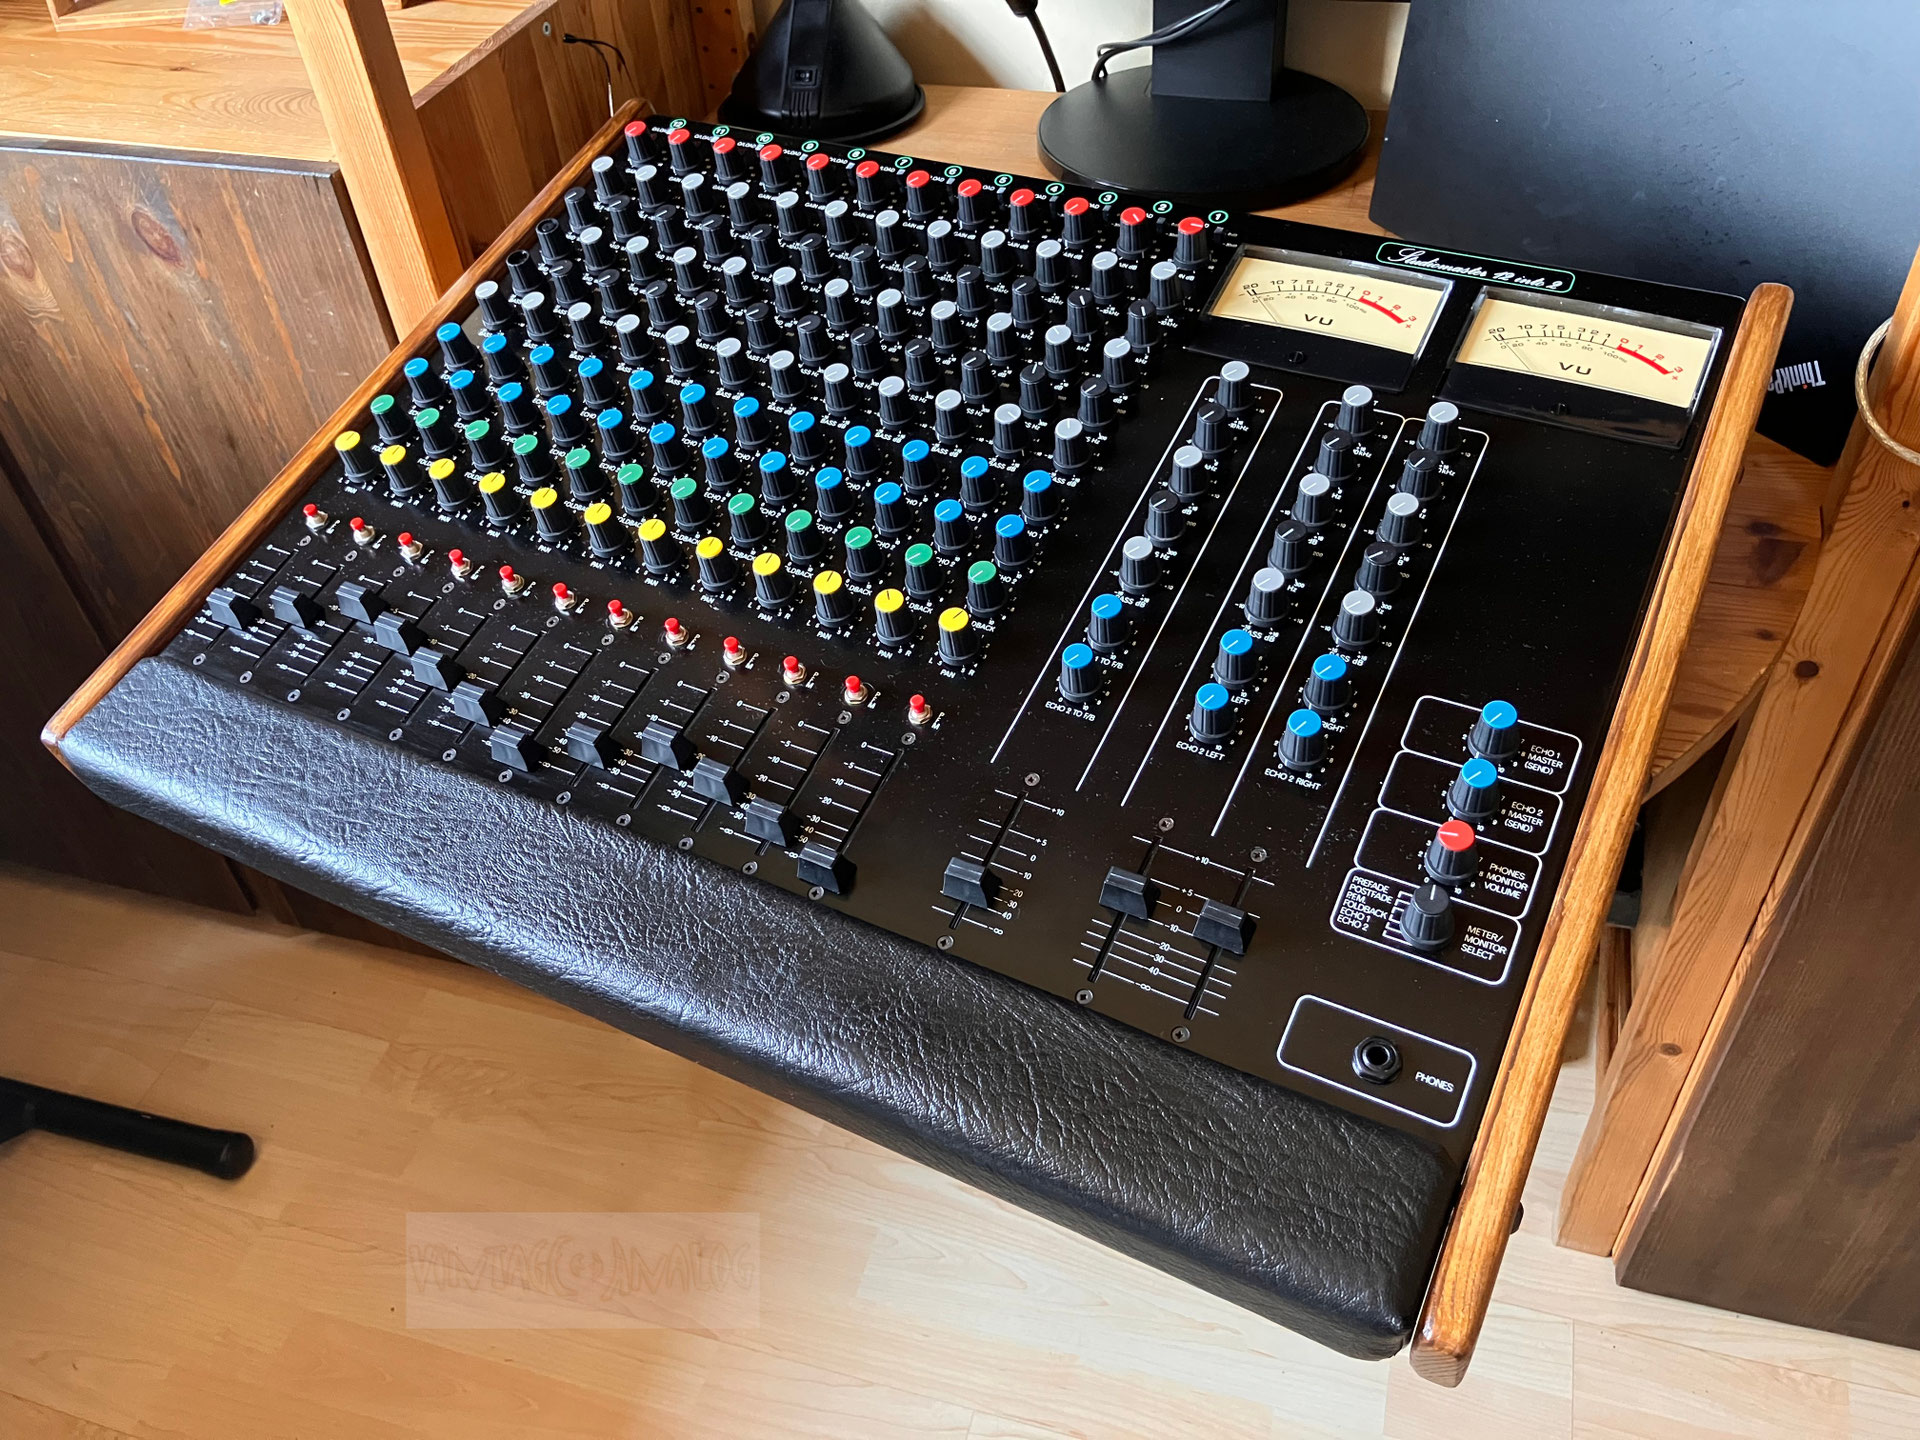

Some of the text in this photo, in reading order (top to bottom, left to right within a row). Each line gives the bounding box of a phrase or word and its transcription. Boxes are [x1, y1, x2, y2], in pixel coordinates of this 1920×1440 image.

[1546, 279, 1562, 290] 2
[1304, 313, 1334, 327] VU
[1559, 361, 1592, 375] VU
[1045, 701, 1066, 712] ECHO
[1176, 740, 1198, 752] ECHO
[1205, 750, 1226, 761] LEFT
[1530, 745, 1554, 757] ECHO
[1524, 761, 1554, 776] (SEND)
[1527, 753, 1564, 769] MASTER
[1264, 768, 1288, 781] ECHO
[1295, 776, 1322, 791] RIGHT
[1511, 801, 1536, 814] ECHO
[1504, 818, 1534, 834] (SEND)
[1508, 810, 1544, 827] MASTER
[1489, 863, 1526, 880] PHONES
[1352, 875, 1390, 894] PREFADE
[1484, 881, 1522, 900] VOLUME
[1486, 872, 1529, 892] MONITOR
[1349, 883, 1394, 904] POSTFADE
[1340, 906, 1365, 921] ECHO
[1343, 899, 1388, 920] FOLDBACK
[1337, 914, 1362, 929] ECHO
[1467, 925, 1504, 942] METER/
[1461, 943, 1495, 961] SELECT
[1464, 934, 1508, 955] MONITOR
[1415, 1071, 1455, 1093] PHONES
